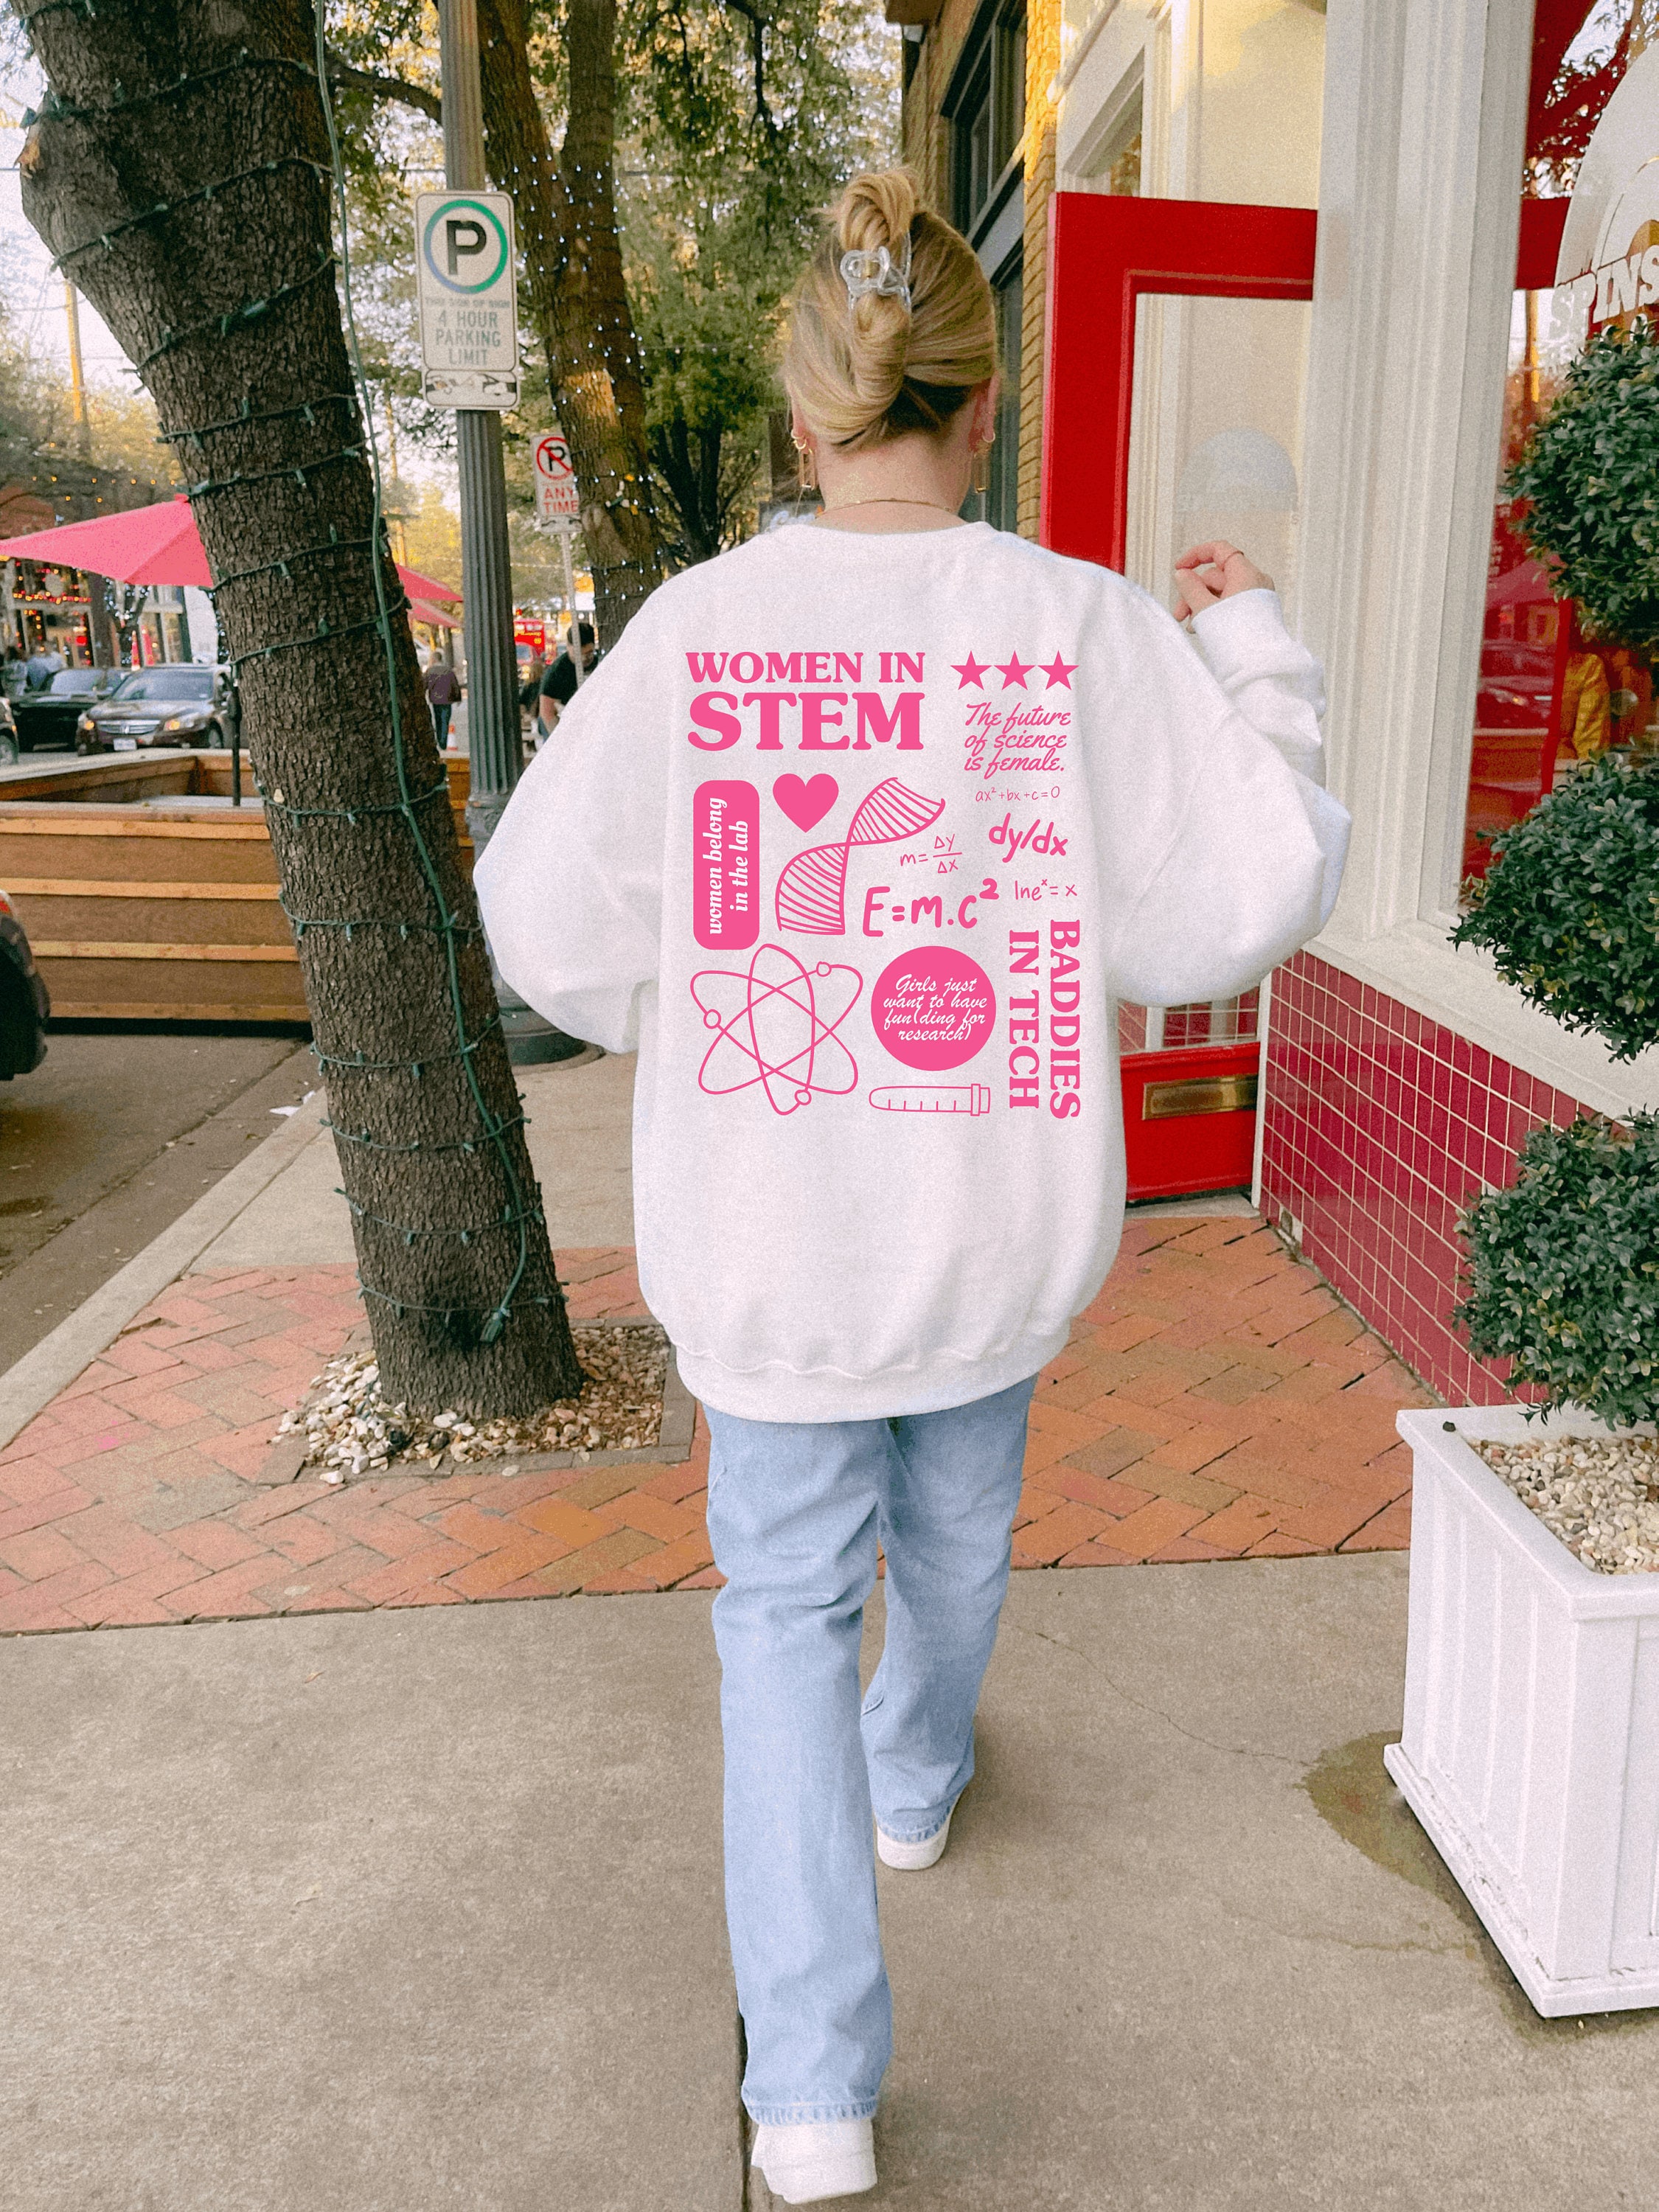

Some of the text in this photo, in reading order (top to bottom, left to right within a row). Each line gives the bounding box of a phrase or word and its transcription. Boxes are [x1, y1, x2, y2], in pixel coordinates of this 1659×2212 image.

[446, 220, 487, 276] P
[438, 310, 498, 328] 4 HOUR
[436, 328, 501, 347] PARKING
[448, 348, 487, 366] LIMIT
[543, 500, 579, 514] TIME
[544, 487, 574, 498] ANY
[686, 652, 925, 683] WOMEN IN
[687, 691, 925, 751] STEM
[965, 702, 1071, 734] The future
[964, 725, 1067, 757] of science
[964, 747, 1065, 779] is female.
[988, 812, 1068, 863] dy/dx
[702, 798, 728, 934] women belong
[728, 820, 748, 912] in the lab
[883, 991, 987, 1009] want to have
[895, 973, 978, 998] Girls just
[883, 1007, 986, 1030] fun(ding for
[898, 1023, 972, 1040] research)
[1008, 929, 1040, 1110] IN TECH
[1050, 919, 1080, 1119] BADDIES
